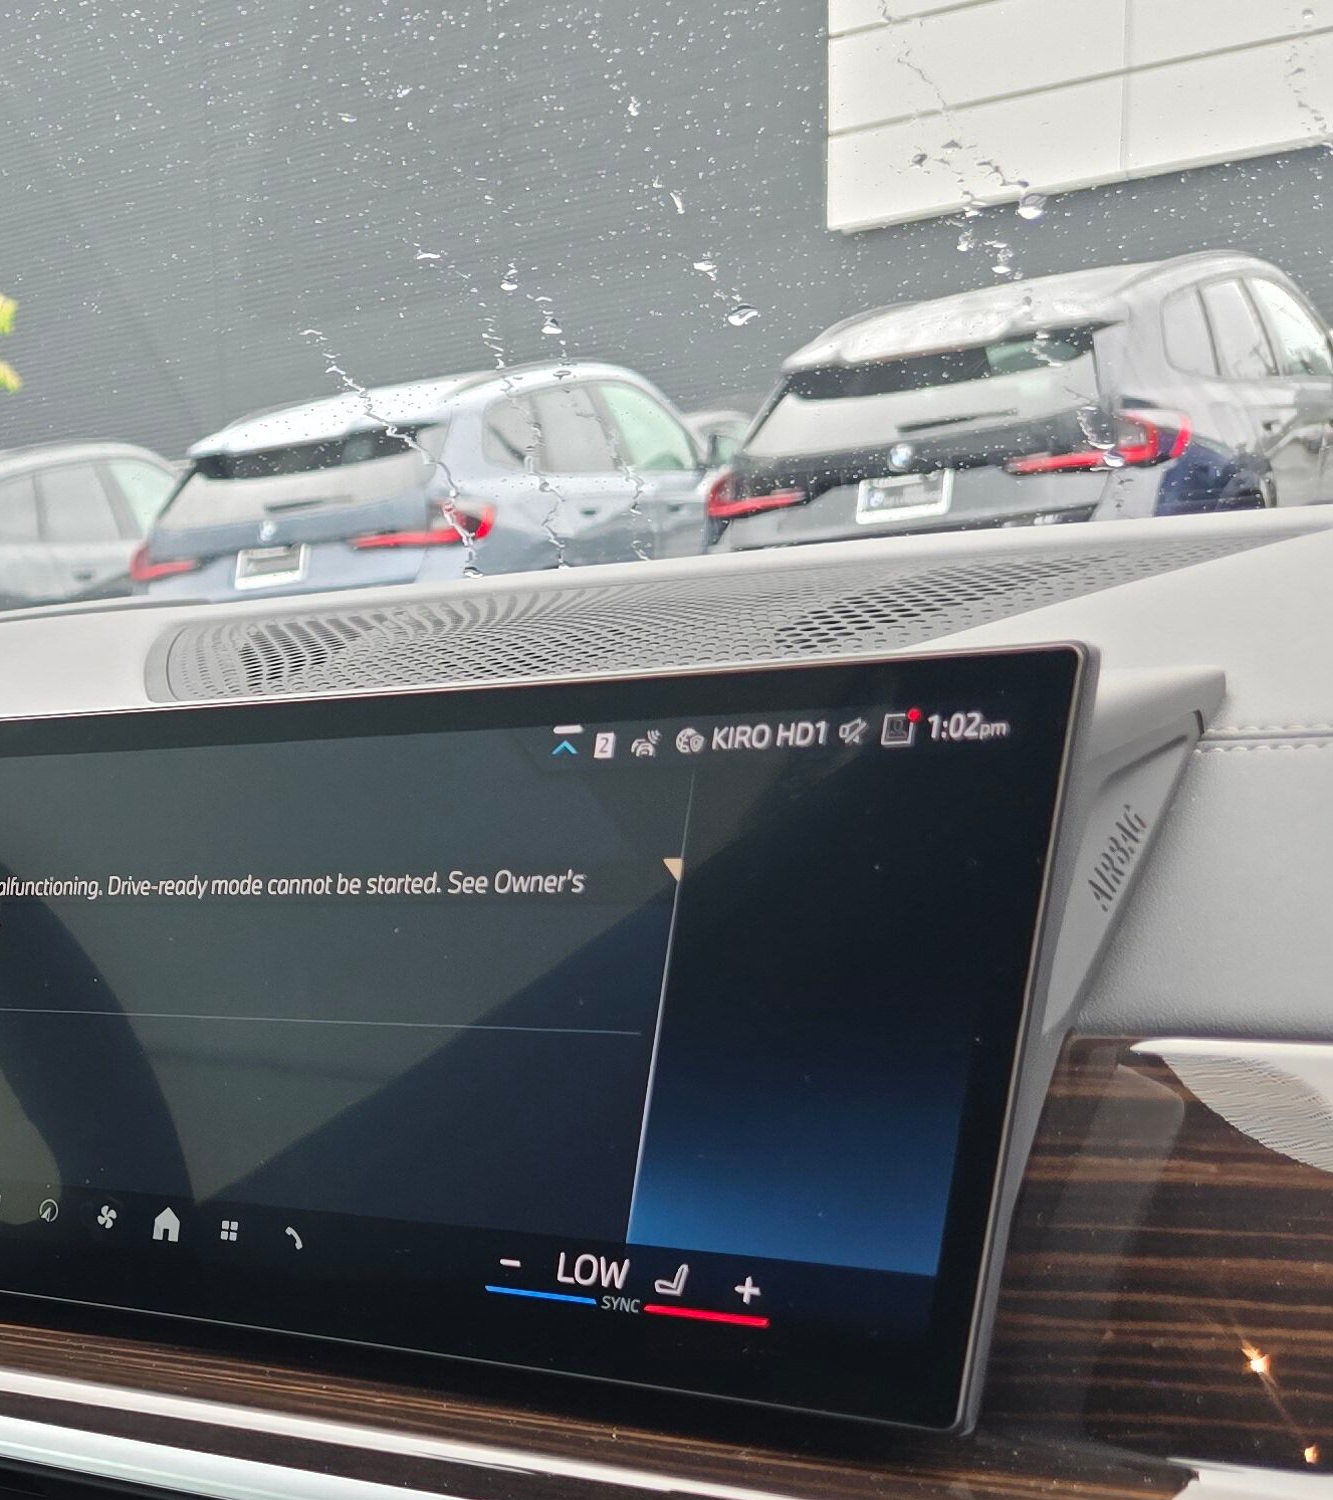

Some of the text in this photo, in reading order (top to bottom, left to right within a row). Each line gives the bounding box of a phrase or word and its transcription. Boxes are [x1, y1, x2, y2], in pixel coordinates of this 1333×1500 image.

[711, 720, 828, 750] KIRO HD1
[107, 874, 208, 900] Drive-ready
[210, 874, 263, 896] mode
[267, 874, 333, 896] cannot
[337, 872, 362, 895] be
[366, 871, 442, 895] started.
[447, 870, 489, 895] See
[494, 868, 586, 894] Owner's
[557, 1252, 630, 1289] LOW
[601, 1295, 641, 1315] SYNC
